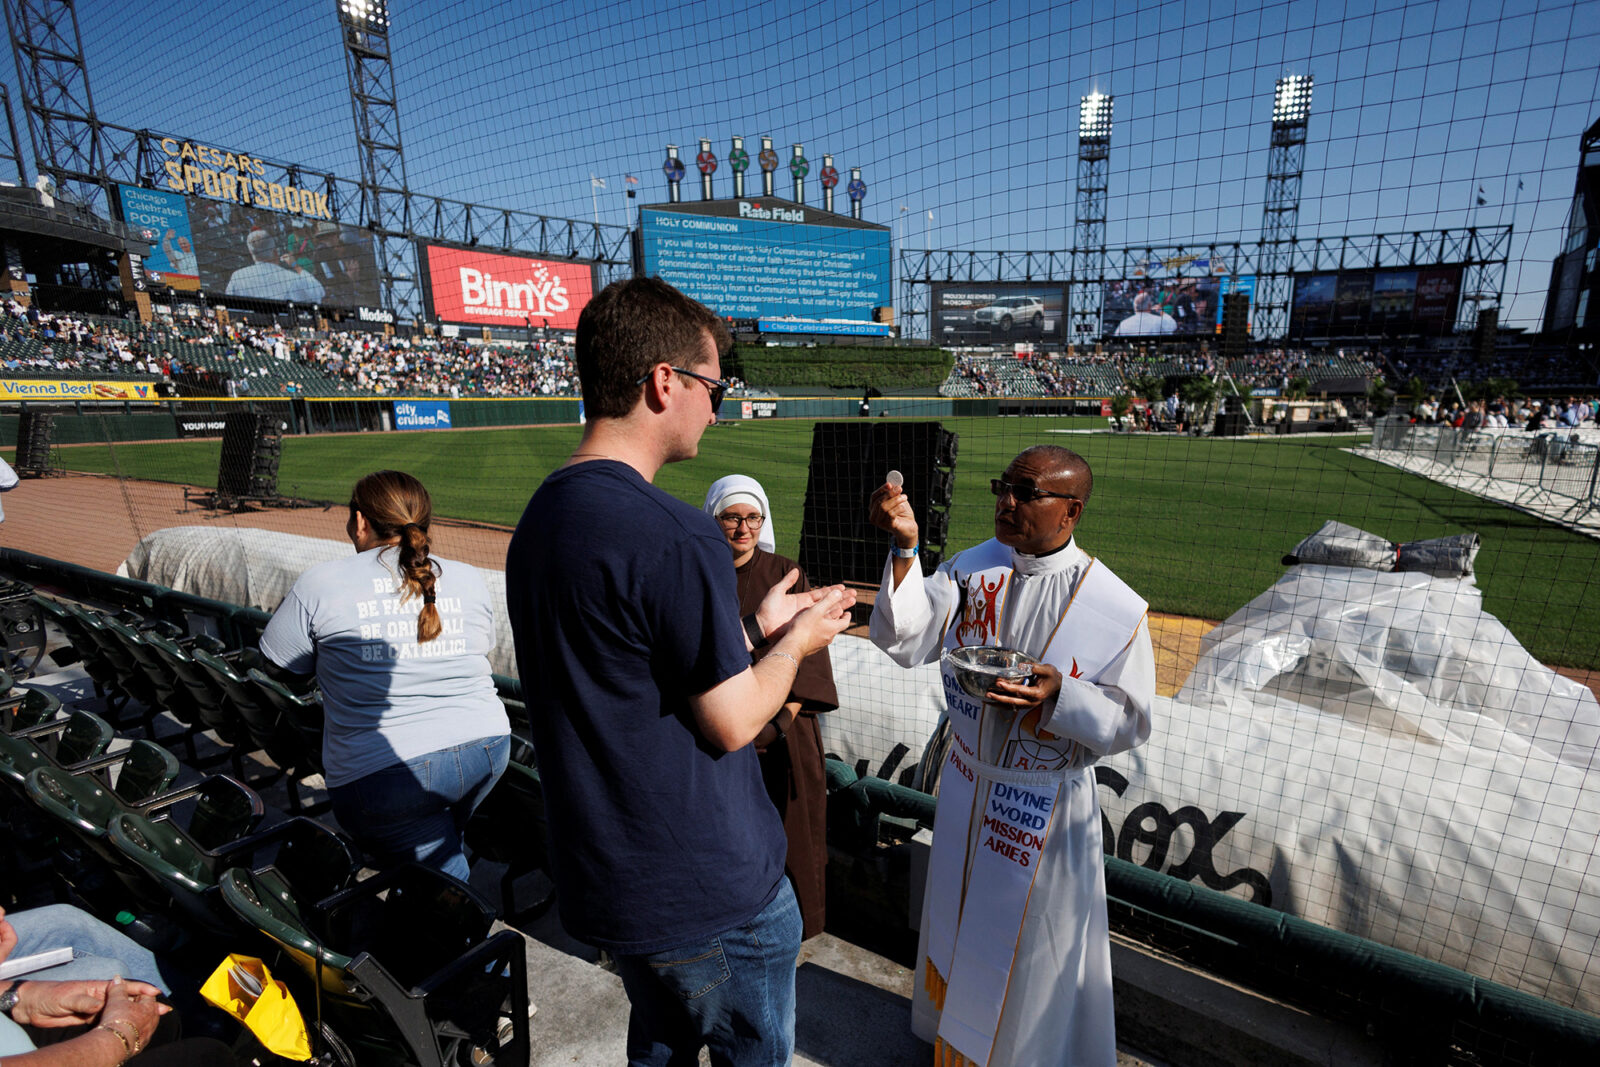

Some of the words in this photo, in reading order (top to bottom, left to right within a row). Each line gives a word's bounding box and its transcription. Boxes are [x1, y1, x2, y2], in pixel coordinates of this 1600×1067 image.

[161, 137, 266, 176] CAESARS
[125, 189, 167, 205] Chicago
[165, 160, 332, 220] SPORTSBOOK
[127, 200, 182, 217] Celebrates
[739, 201, 771, 220] Rate
[773, 207, 804, 222] Field
[129, 212, 169, 228] POPE
[656, 217, 680, 228] HOLY
[682, 219, 738, 233] COMMUNION
[657, 238, 662, 246] If
[664, 240, 679, 249] you
[681, 240, 693, 248] will
[695, 241, 707, 249] not
[709, 242, 719, 250] be
[720, 243, 754, 254] receiving
[756, 245, 771, 255] Holy
[773, 246, 816, 257] Communion
[817, 250, 829, 259] (for
[830, 250, 859, 261] example
[696, 252, 727, 261] member
[738, 254, 765, 263] another
[767, 256, 782, 264] faith
[784, 257, 812, 266] tradition
[823, 260, 852, 269] Christian
[659, 269, 705, 280] Communion
[707, 274, 721, 282] you
[737, 274, 755, 282] most
[757, 275, 788, 284] welcome
[790, 277, 797, 285] to
[819, 279, 844, 288] forward
[846, 280, 858, 288] and
[716, 263, 741, 273] please
[743, 265, 762, 273] know
[764, 266, 778, 274] that
[779, 267, 801, 277] during
[803, 268, 814, 276] the
[815, 269, 852, 278] distribution
[862, 272, 877, 281] Holy
[459, 266, 569, 318] Binny's
[697, 282, 727, 292] blessing
[729, 284, 745, 292] from
[754, 285, 797, 294] Communion
[829, 289, 851, 298] Simply
[853, 290, 878, 298] indicate
[702, 292, 723, 302] taking
[725, 293, 738, 301] the
[739, 294, 783, 303] consecrated
[784, 296, 801, 305] host,
[815, 297, 835, 305] rather
[837, 299, 844, 308] by
[846, 299, 874, 309] crossing
[359, 306, 394, 323] Modelo
[464, 306, 503, 316] BEVERAGE
[505, 309, 529, 318] DEPOT
[772, 323, 797, 331] Chicago
[2, 382, 57, 394] Vienna
[61, 383, 92, 394] Beef
[396, 403, 416, 416] city
[752, 402, 777, 410] STREAM
[182, 422, 206, 431] YOUR
[397, 414, 436, 425] cruises
[372, 578, 394, 594] BE
[356, 600, 380, 619] BE
[382, 597, 462, 616] FAITUL!
[359, 623, 382, 641] BE
[387, 618, 465, 638] ORIAL!
[361, 645, 383, 662] BE
[388, 638, 466, 660] CATHOLIC!
[944, 690, 981, 721] HEART
[994, 782, 1052, 813] DIVINE
[992, 799, 1046, 831] WORD
[983, 815, 1045, 851] MISSION
[983, 836, 1030, 868] ARIES
